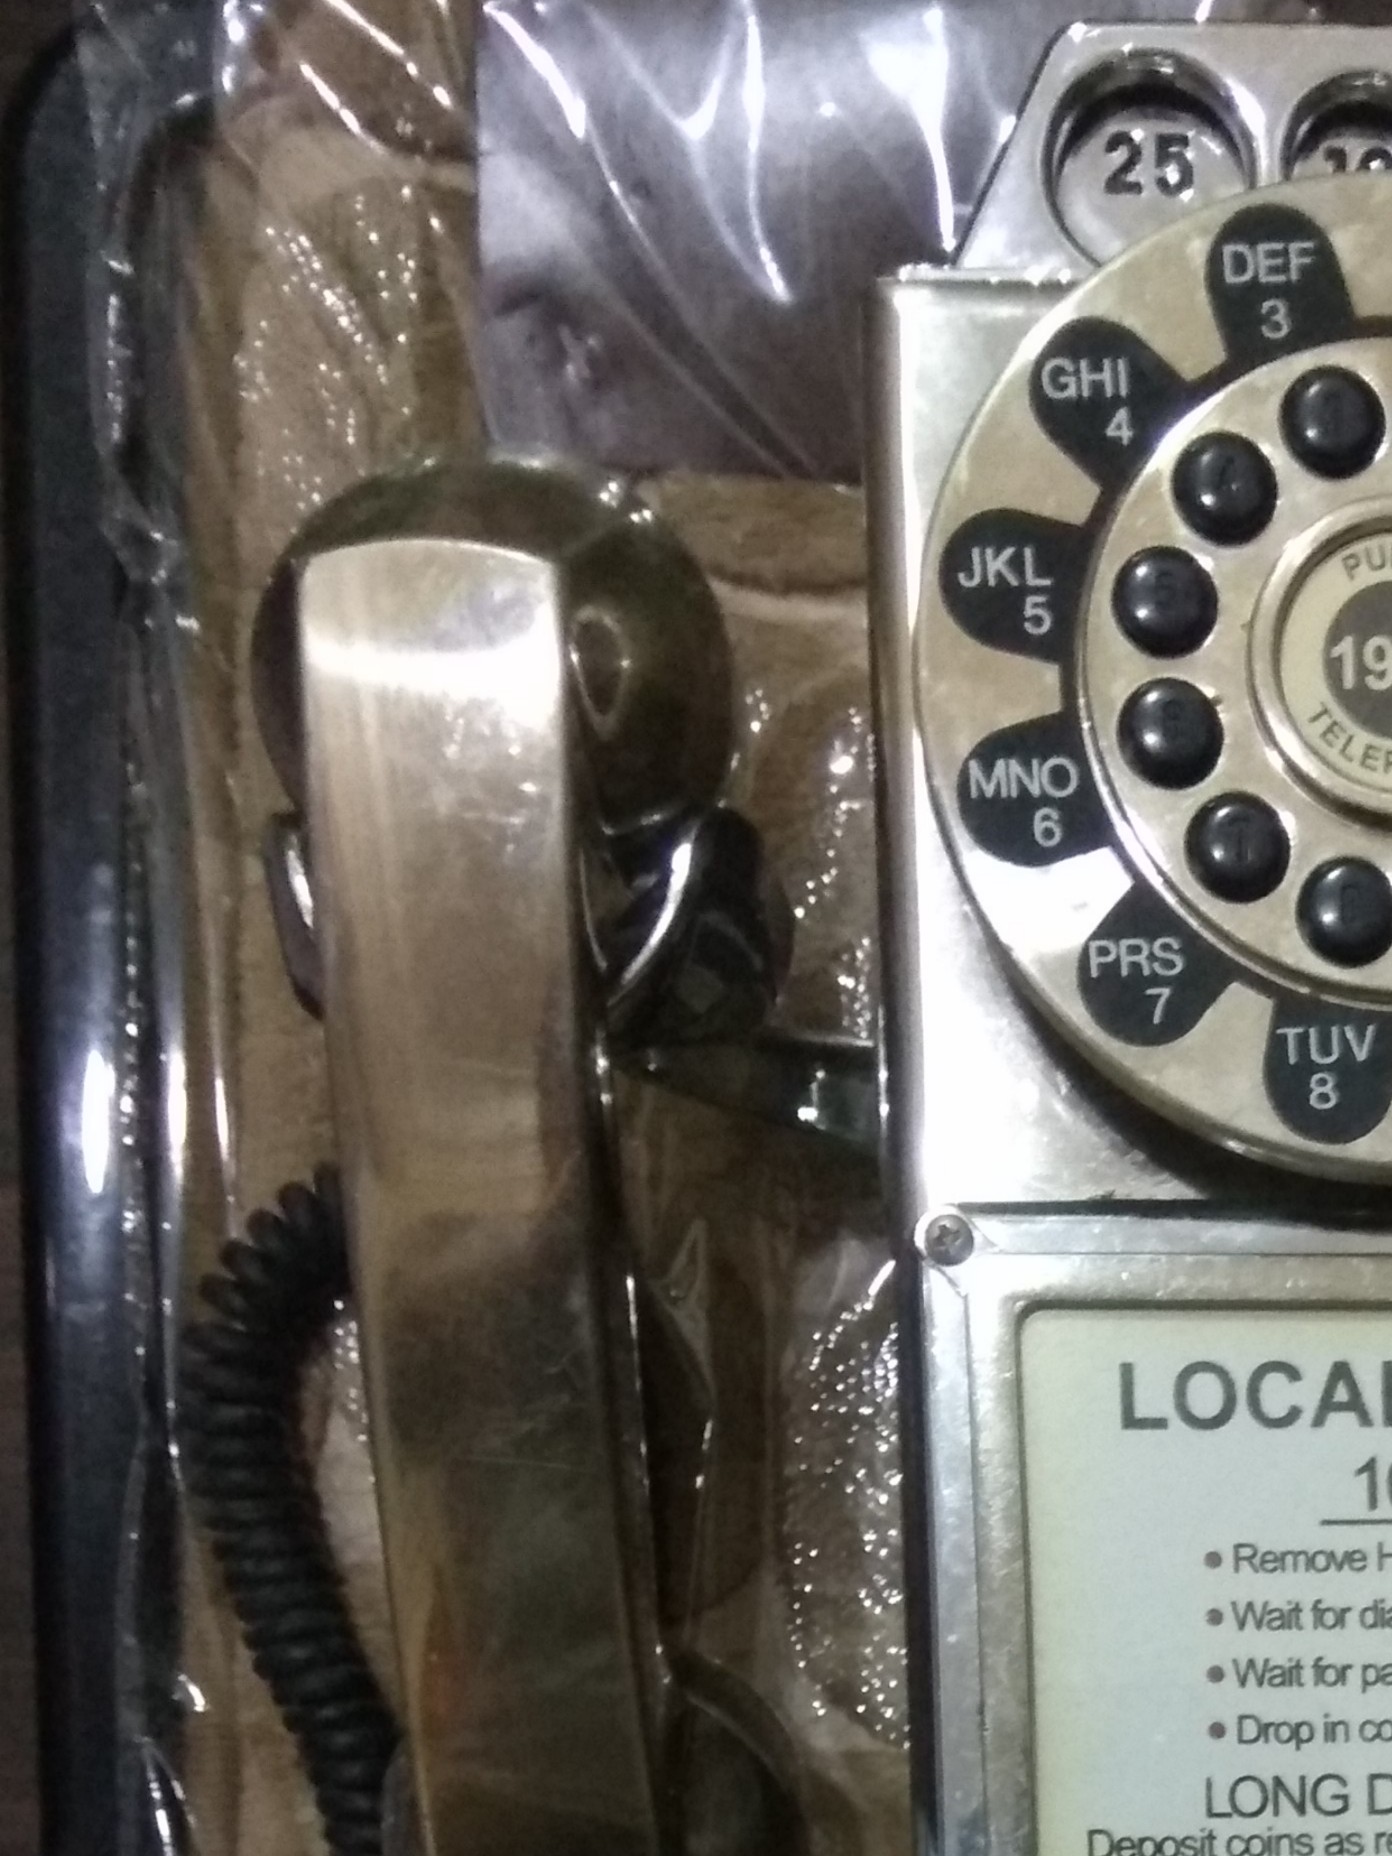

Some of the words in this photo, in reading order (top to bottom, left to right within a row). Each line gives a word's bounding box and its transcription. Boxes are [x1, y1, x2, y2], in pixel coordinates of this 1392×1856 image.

[1104, 130, 1194, 200] 25
[1222, 242, 1316, 285] DEF
[1261, 300, 1292, 339] 3
[1041, 357, 1130, 399] GHI
[1105, 407, 1134, 446] 4
[958, 547, 1052, 587] JKL
[1023, 596, 1052, 635] 5
[968, 756, 1080, 799] MNO
[1033, 807, 1063, 847] 6
[1088, 937, 1185, 978] PRS
[1145, 986, 1172, 1025] 7
[1276, 1023, 1377, 1065] TUV
[1309, 1072, 1339, 1110] 8
[1232, 1542, 1367, 1574] Remove
[1231, 1599, 1303, 1631] Wait
[1311, 1598, 1351, 1630] for
[1232, 1656, 1304, 1689] Wait
[1312, 1655, 1352, 1687] for
[1236, 1713, 1314, 1751] Drop
[1323, 1713, 1350, 1743] in
[1205, 1773, 1350, 1819] LONG
[1324, 1831, 1365, 1856] as
